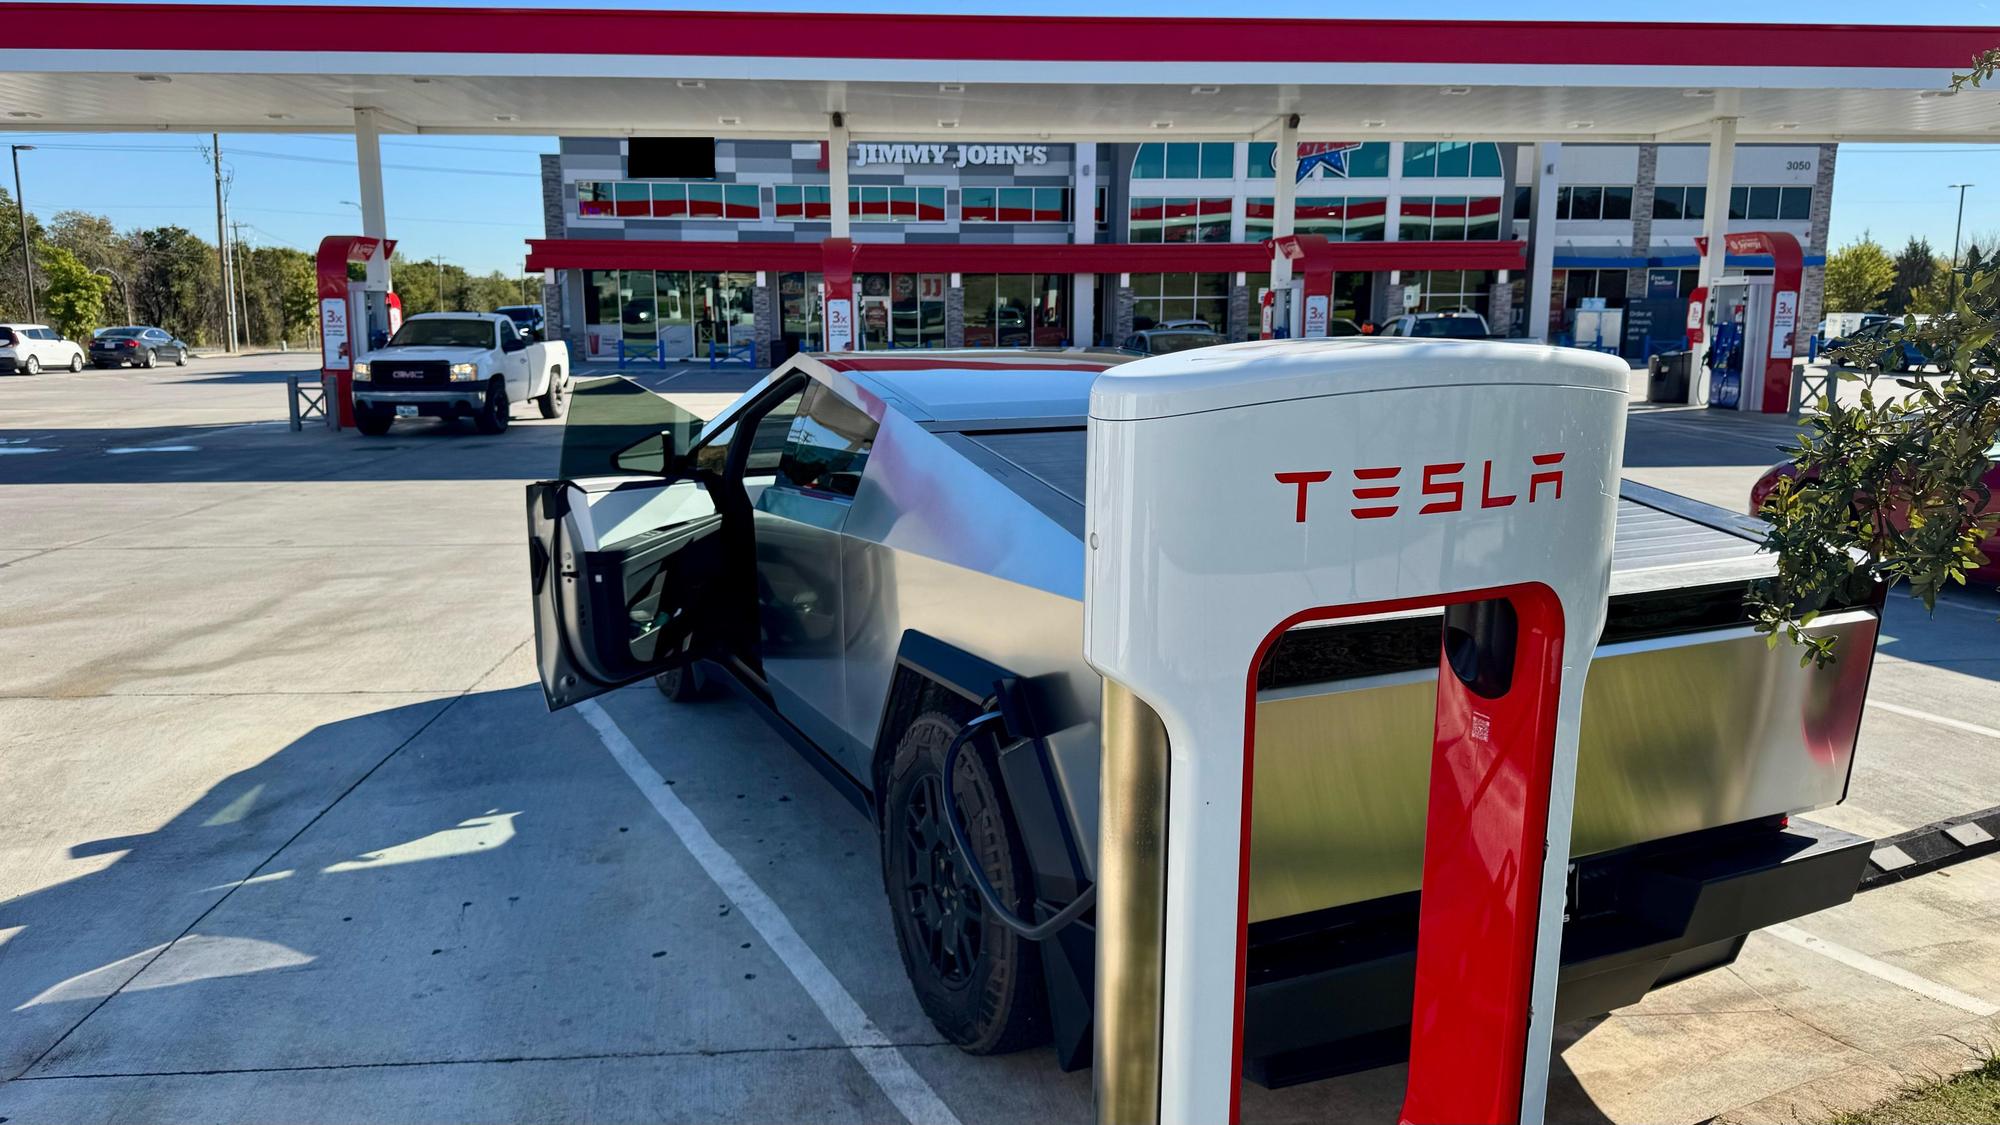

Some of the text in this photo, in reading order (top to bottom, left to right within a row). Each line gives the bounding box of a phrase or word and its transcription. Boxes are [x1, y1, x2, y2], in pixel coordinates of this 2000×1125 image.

[855, 143, 1047, 168] JIMMY JOHN'S
[1786, 161, 1811, 171] 3050
[1309, 306, 1325, 320] 3x
[1778, 301, 1793, 315] 3x
[327, 309, 343, 323] 3x
[832, 310, 848, 324] 3x
[392, 370, 424, 379] GMC
[1274, 452, 1566, 523] TESLA
